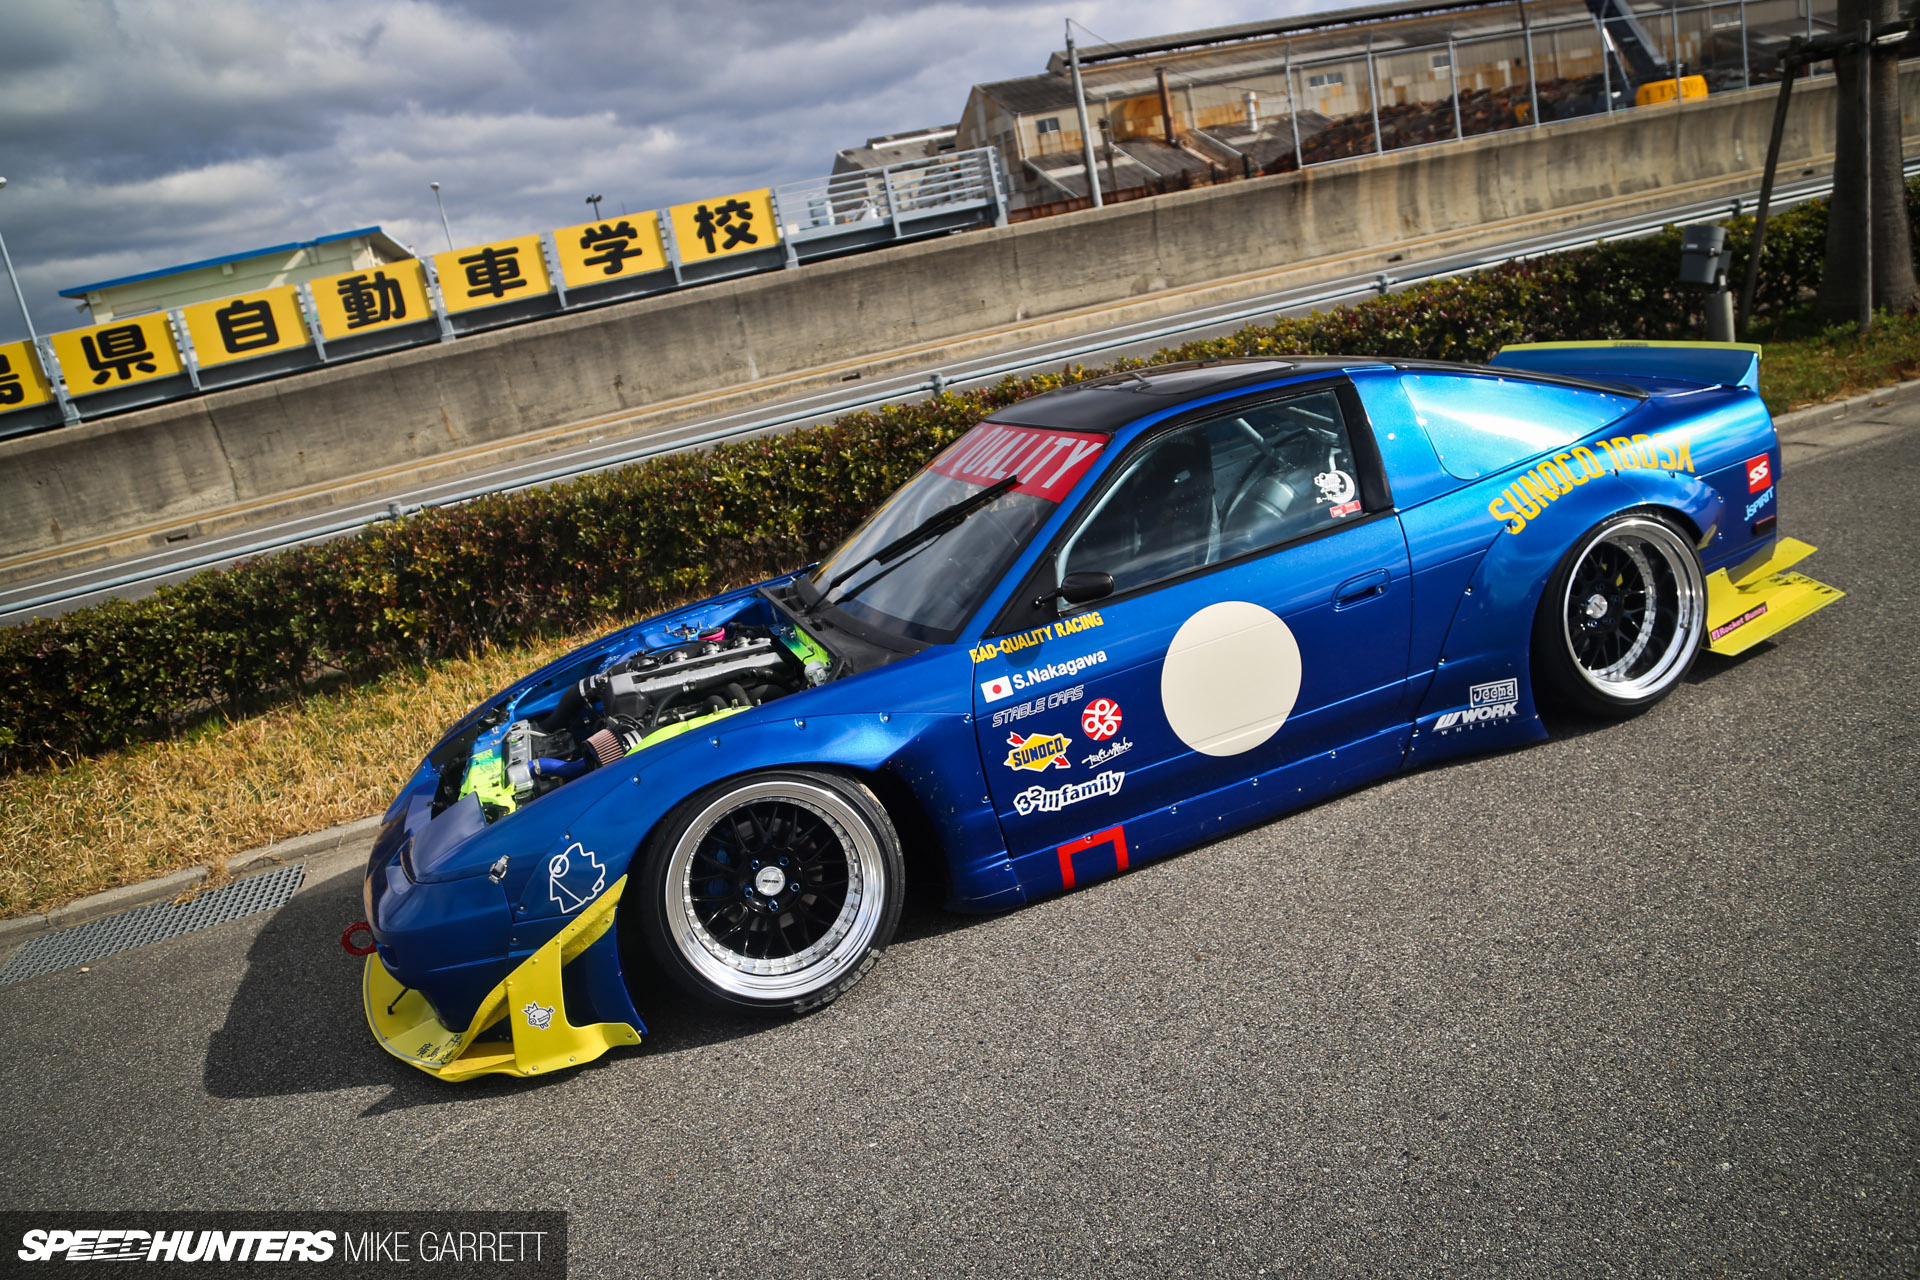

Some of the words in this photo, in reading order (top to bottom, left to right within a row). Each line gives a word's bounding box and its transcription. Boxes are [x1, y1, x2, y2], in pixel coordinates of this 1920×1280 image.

[949, 426, 1104, 489] QUALITY
[1488, 446, 1606, 535] SUNOCO
[968, 625, 1053, 664] BAD-QUALITY
[1053, 611, 1105, 638] RACING
[1012, 650, 1108, 690] S.Nakagawa
[992, 697, 1046, 728] STABLE
[1047, 684, 1085, 709] CARS
[1461, 701, 1518, 724] WORK
[1012, 737, 1065, 768] SUNOCO
